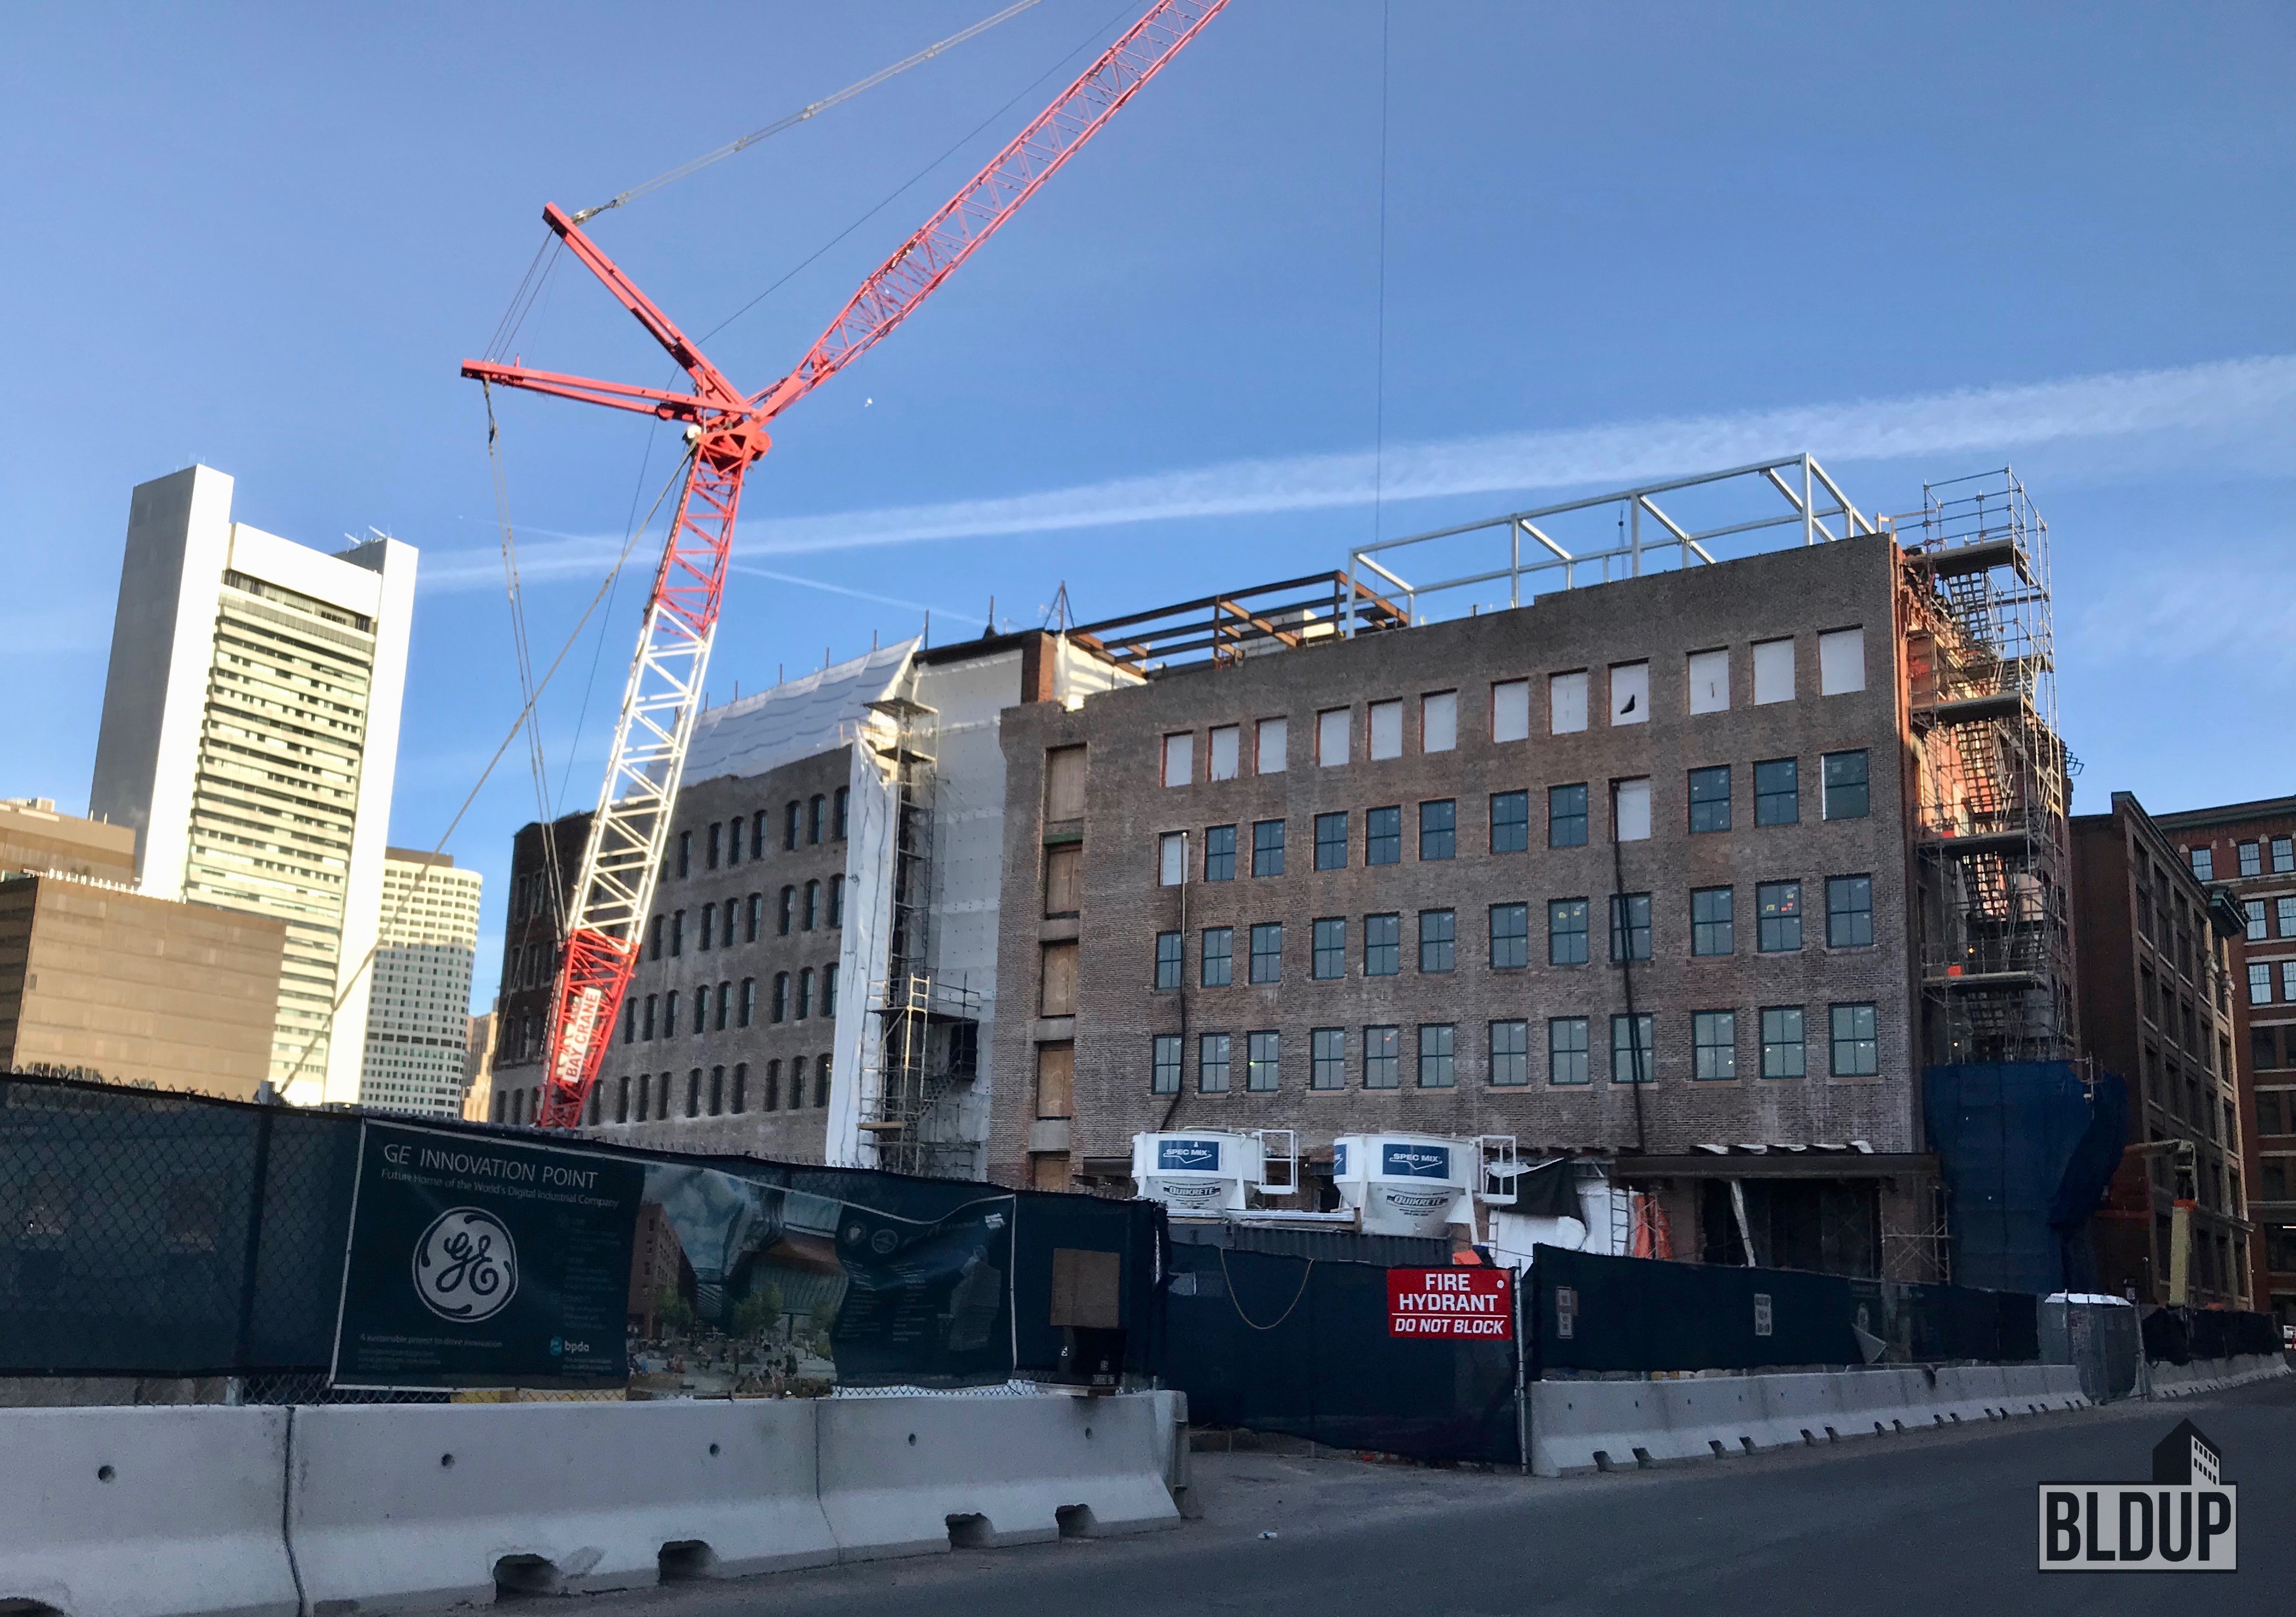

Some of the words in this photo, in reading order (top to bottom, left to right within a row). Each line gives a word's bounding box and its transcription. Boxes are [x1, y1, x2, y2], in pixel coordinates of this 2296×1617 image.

[566, 1048, 582, 1077] BAY
[575, 992, 598, 1044] CRANE
[384, 1143, 412, 1165] GE
[420, 1148, 535, 1182] INNOVATION
[543, 1166, 599, 1189] POINT
[1421, 1153, 1439, 1163] MIX
[381, 1168, 412, 1182] Future
[413, 1174, 442, 1187] Home
[445, 1178, 456, 1187] of
[457, 1179, 472, 1190] the
[508, 1185, 536, 1199] Digital
[578, 1194, 620, 1210] Company
[1169, 1186, 1214, 1196] QUIKRETE
[1394, 1194, 1443, 1207] QUIKRETE
[1426, 1274, 1470, 1291] FIRE
[1399, 1293, 1498, 1312] HYDRANT
[1395, 1318, 1416, 1332] DO
[1420, 1319, 1451, 1333] NOT
[1453, 1319, 1505, 1334] BLOCK
[564, 1340, 589, 1354] bpda
